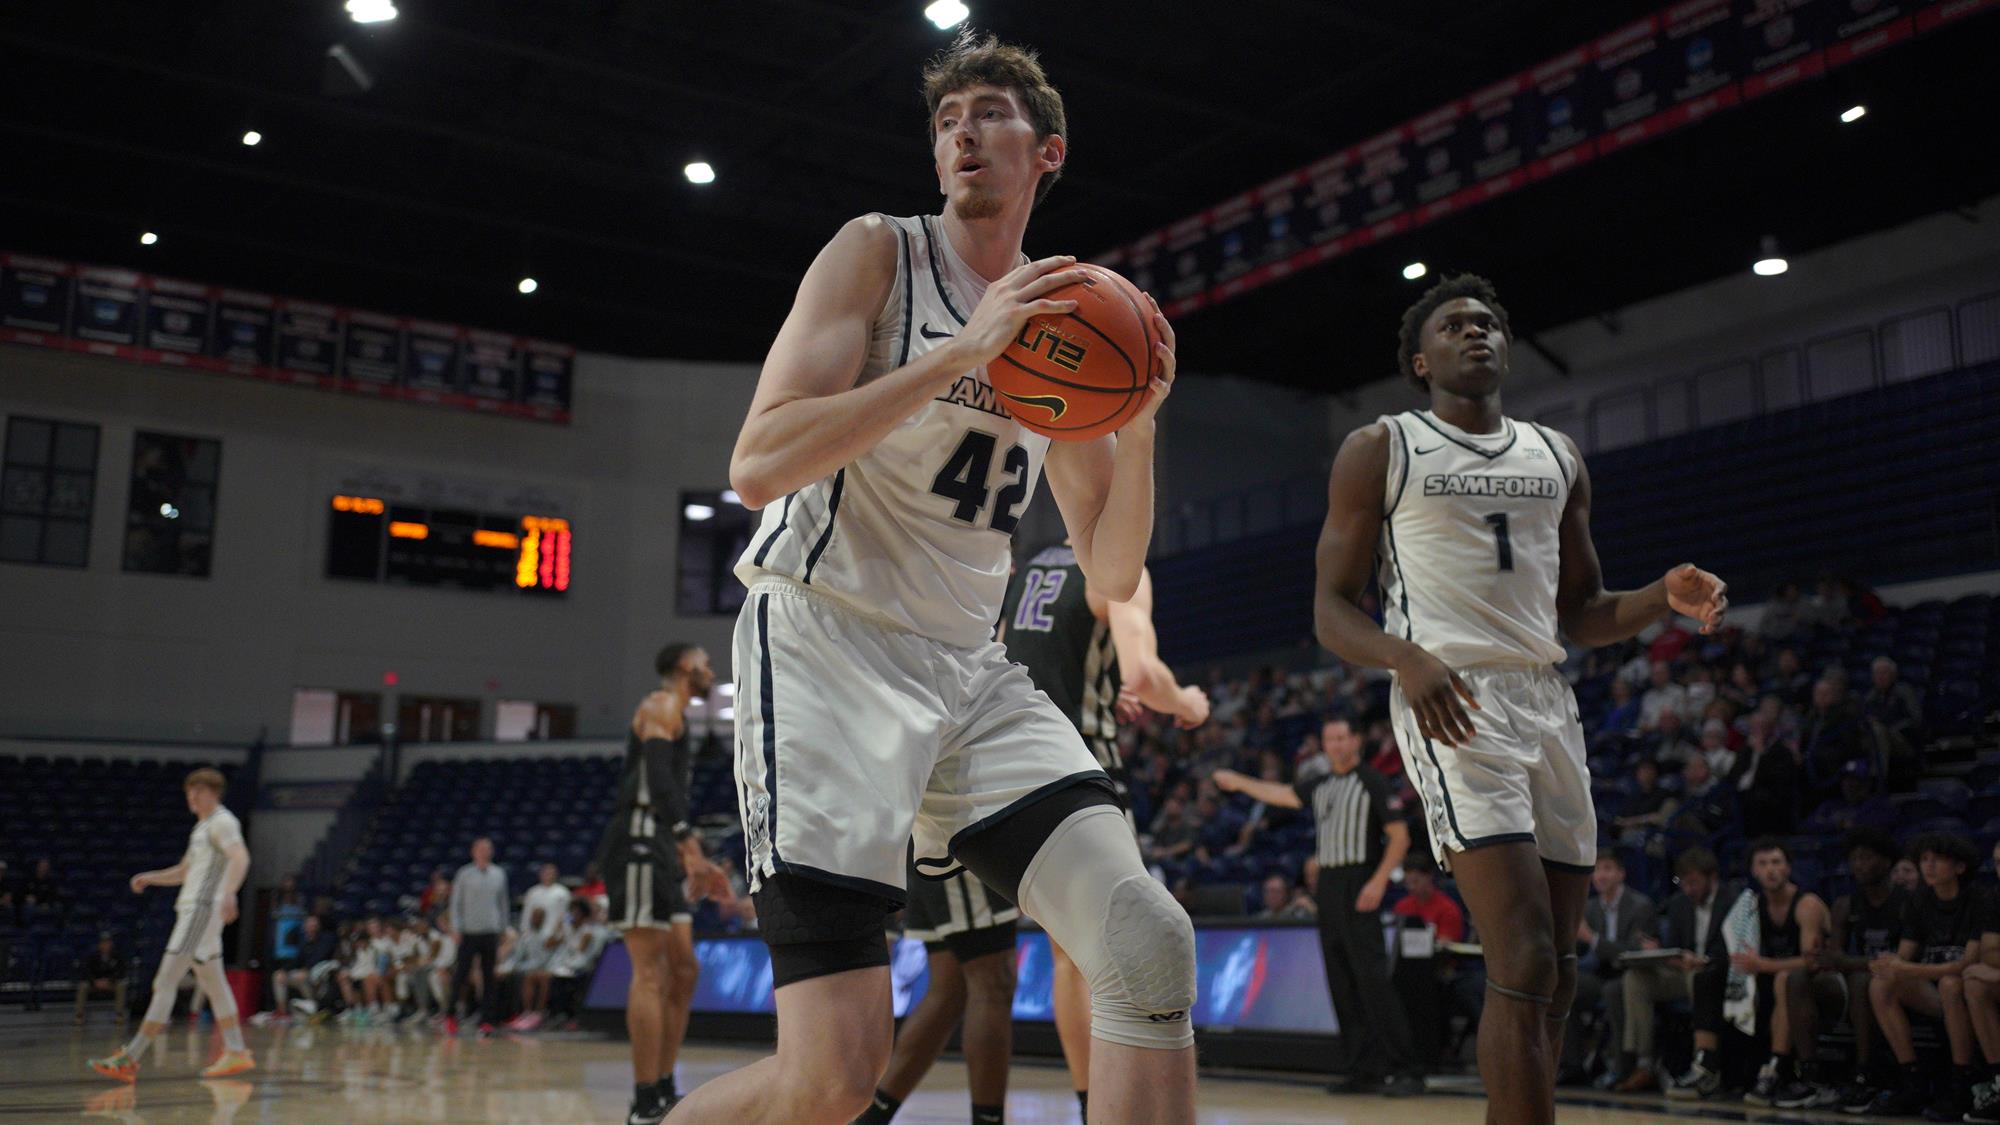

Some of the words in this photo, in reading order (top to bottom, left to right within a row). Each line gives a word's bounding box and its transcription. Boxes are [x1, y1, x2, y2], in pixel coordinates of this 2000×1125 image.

[1013, 320, 1087, 373] LITE
[930, 427, 1029, 537] 42
[1424, 474, 1558, 499] SAMFORD
[1485, 513, 1513, 571] 1
[1013, 569, 1068, 632] 12
